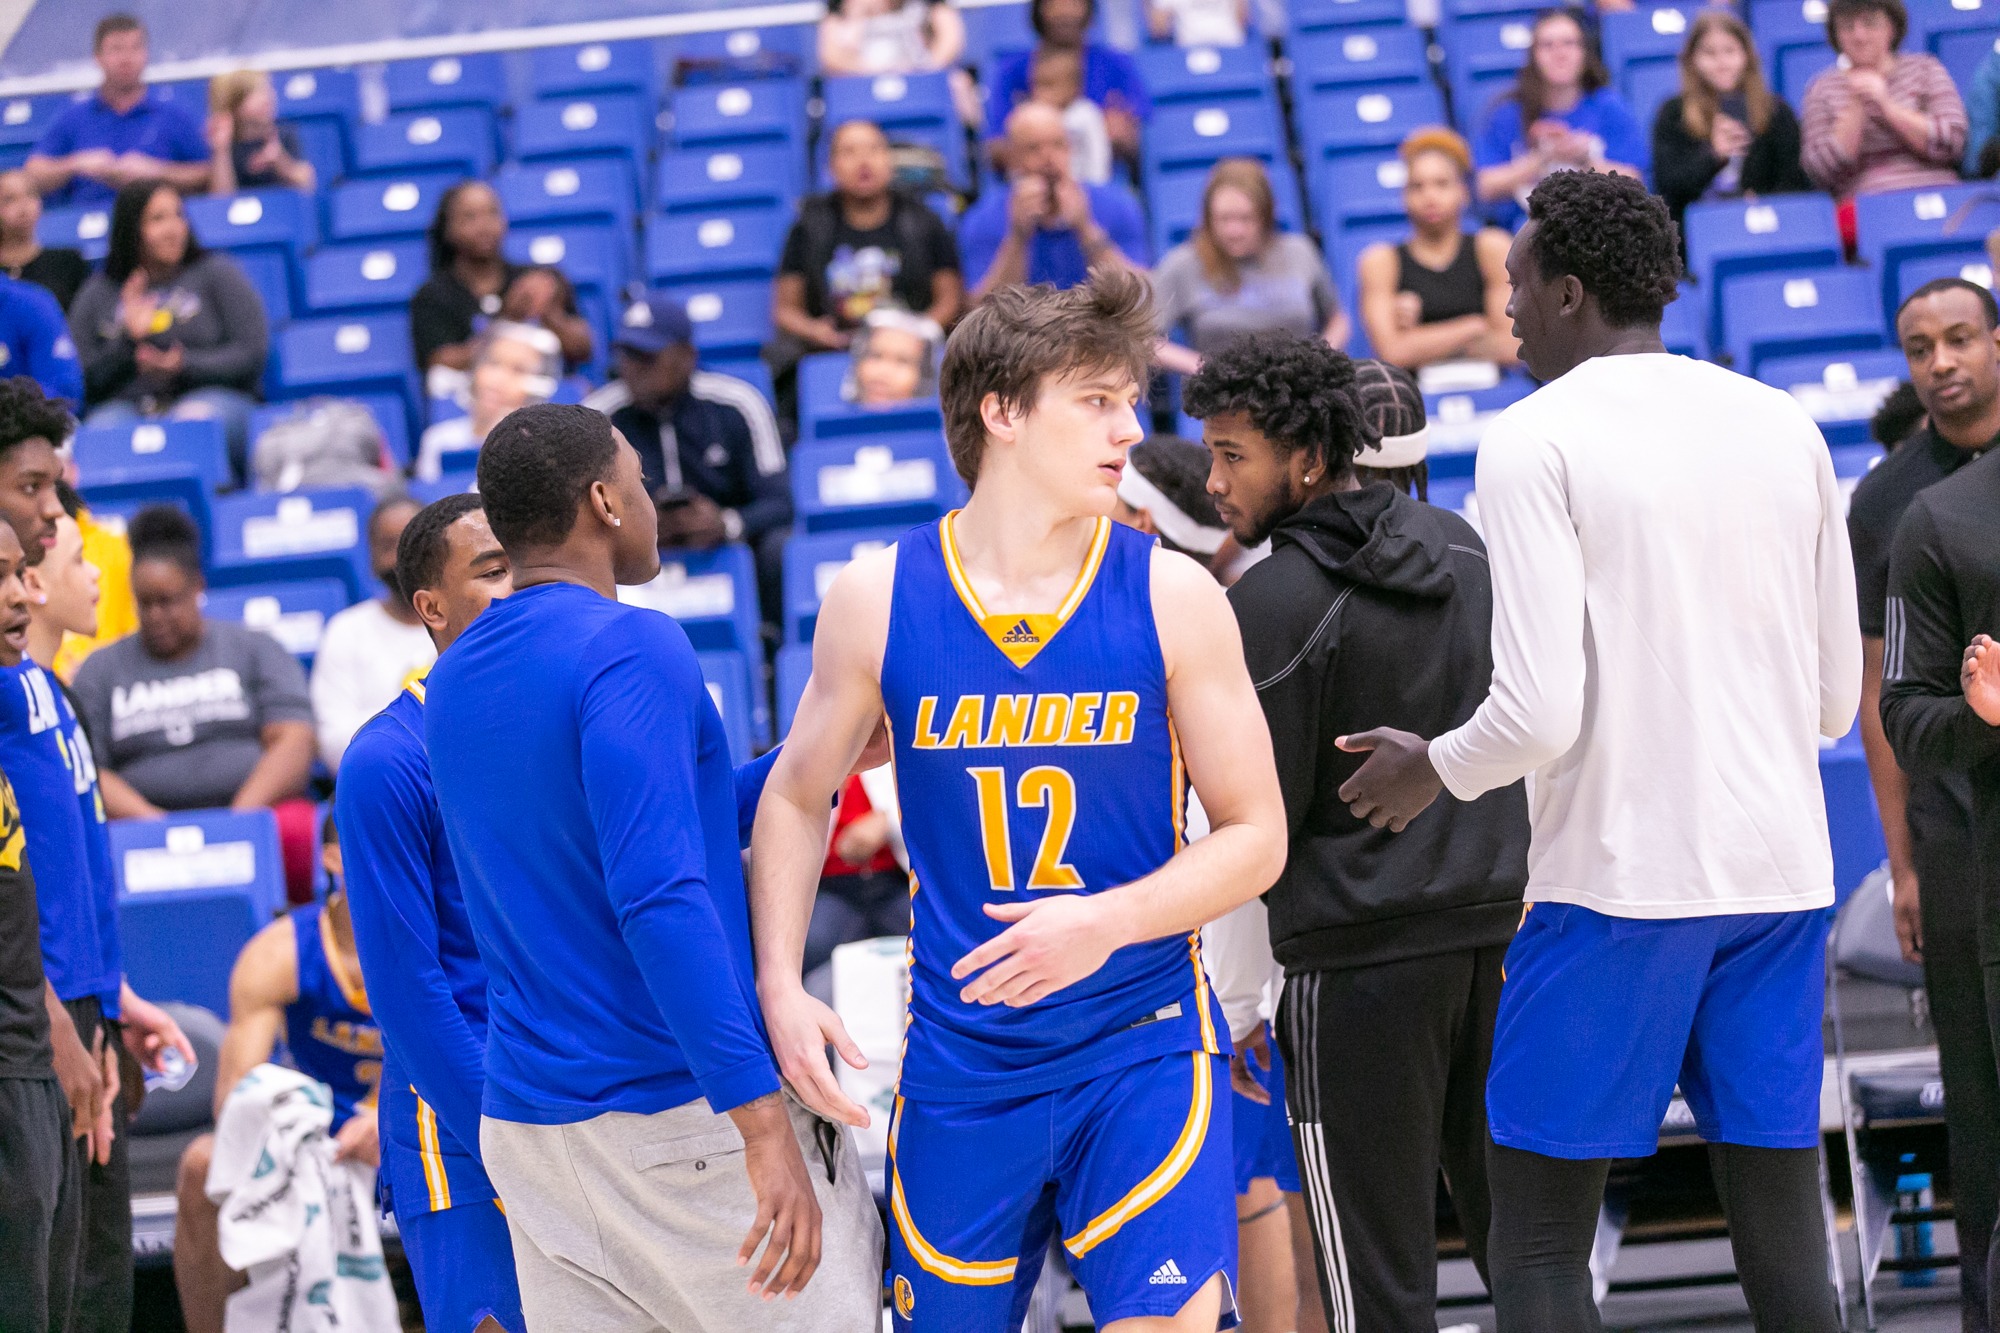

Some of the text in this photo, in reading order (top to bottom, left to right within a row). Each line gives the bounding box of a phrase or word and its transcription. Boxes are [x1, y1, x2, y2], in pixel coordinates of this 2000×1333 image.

[1002, 634, 1040, 643] adidas
[912, 691, 1140, 749] LANDER
[965, 765, 1087, 892] 12
[1149, 1274, 1188, 1285] adidas
